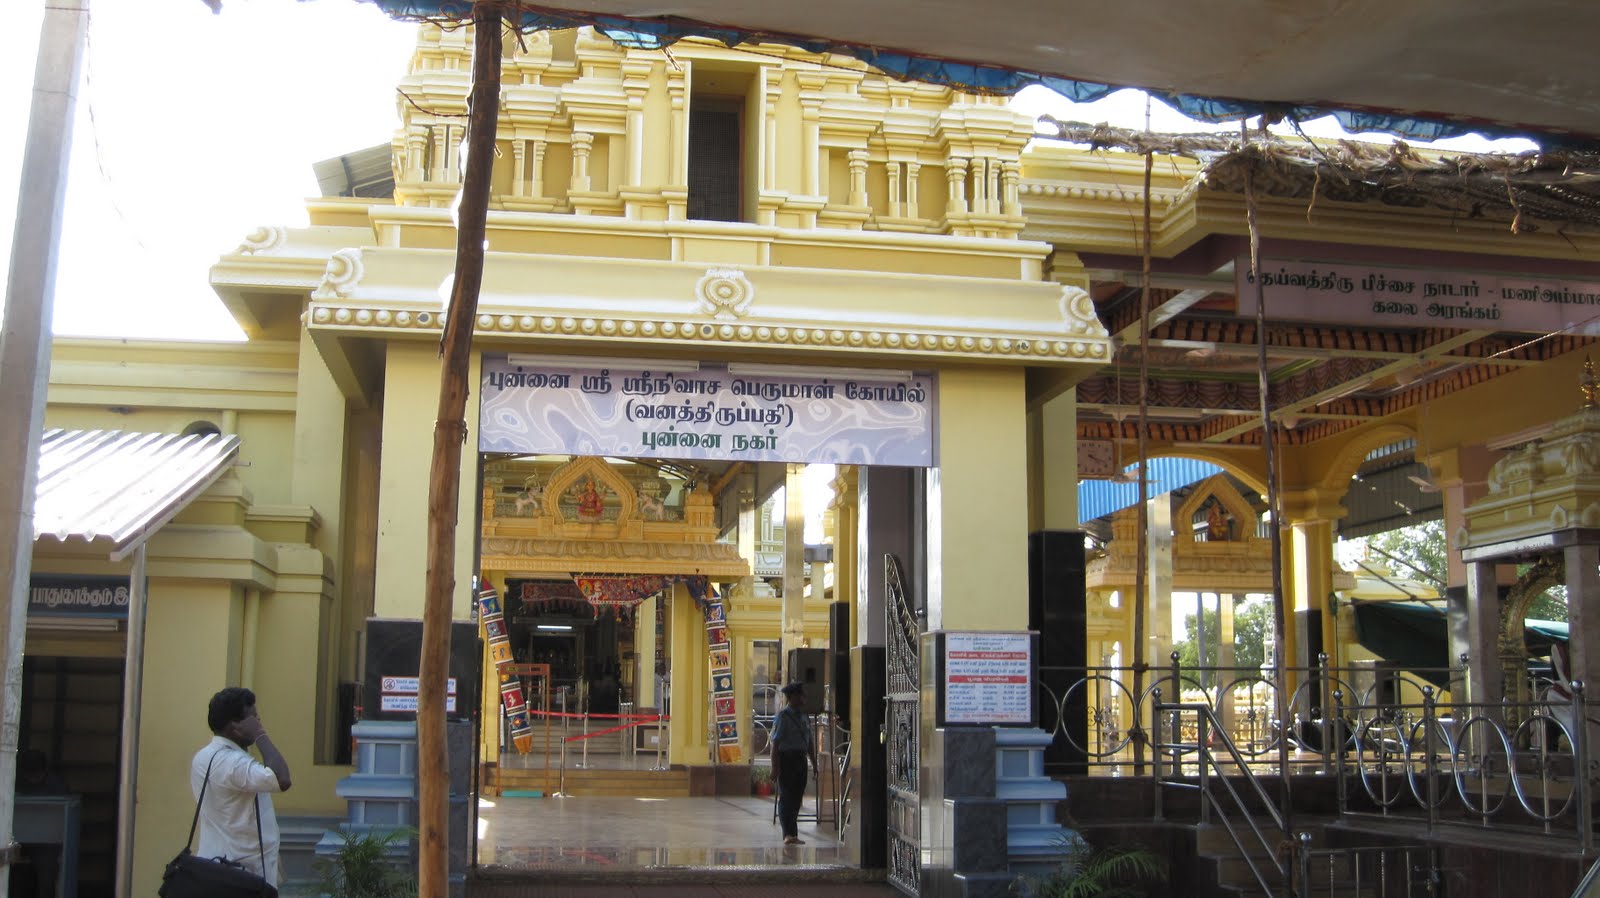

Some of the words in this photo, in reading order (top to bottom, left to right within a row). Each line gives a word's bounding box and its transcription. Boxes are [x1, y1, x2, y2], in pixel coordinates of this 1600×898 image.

[1361, 273, 1416, 294] பிச்சை
[1422, 279, 1480, 300] நாடார்
[1372, 301, 1418, 316] கலை
[1425, 301, 1501, 320] அரங்கம்
[489, 366, 571, 391] புன்னை
[731, 378, 835, 401] பெருமாள்
[845, 381, 926, 403] கோயில்
[625, 398, 794, 428] (வனத்திருப்பதி)
[642, 425, 722, 450] புன்னை
[730, 428, 778, 454] நகர்
